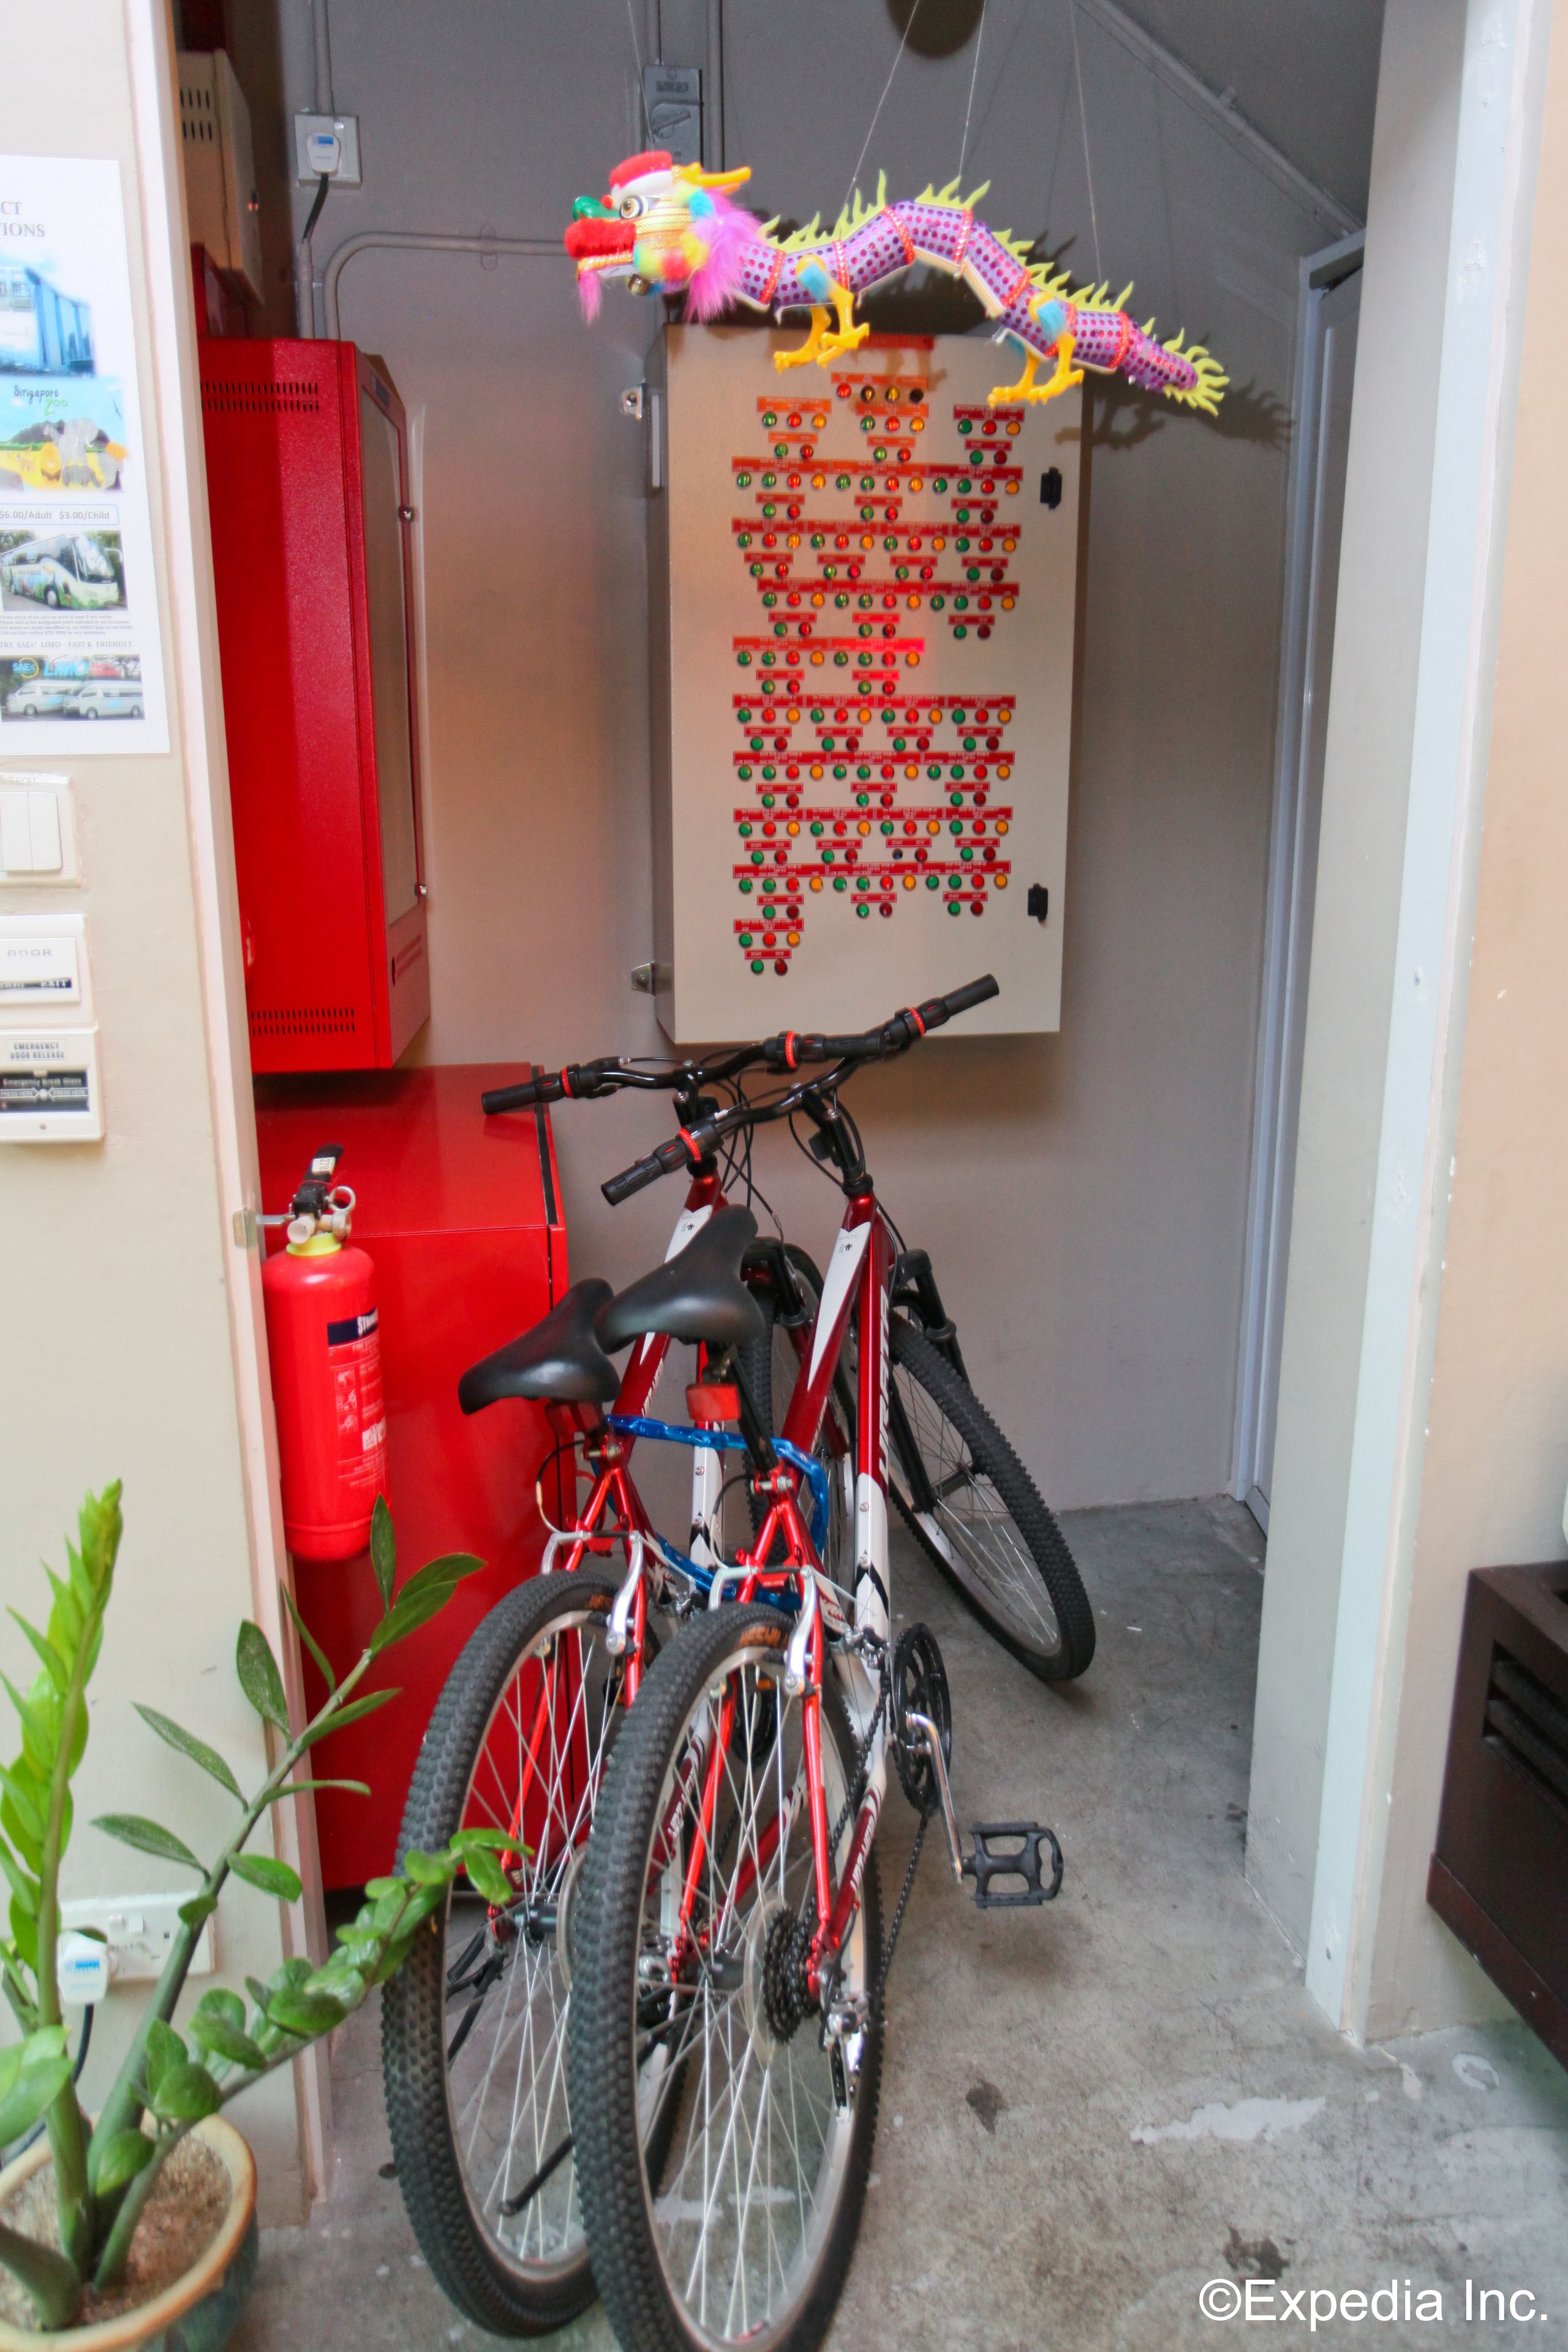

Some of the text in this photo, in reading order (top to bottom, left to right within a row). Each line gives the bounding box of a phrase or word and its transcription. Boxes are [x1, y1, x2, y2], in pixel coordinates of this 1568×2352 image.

[13, 385, 59, 405] Singapore
[59, 511, 110, 521] $3.00/Child
[3, 1078, 41, 1088] Emergency
[62, 1077, 82, 1085] Glass
[319, 1158, 330, 1170] 278
